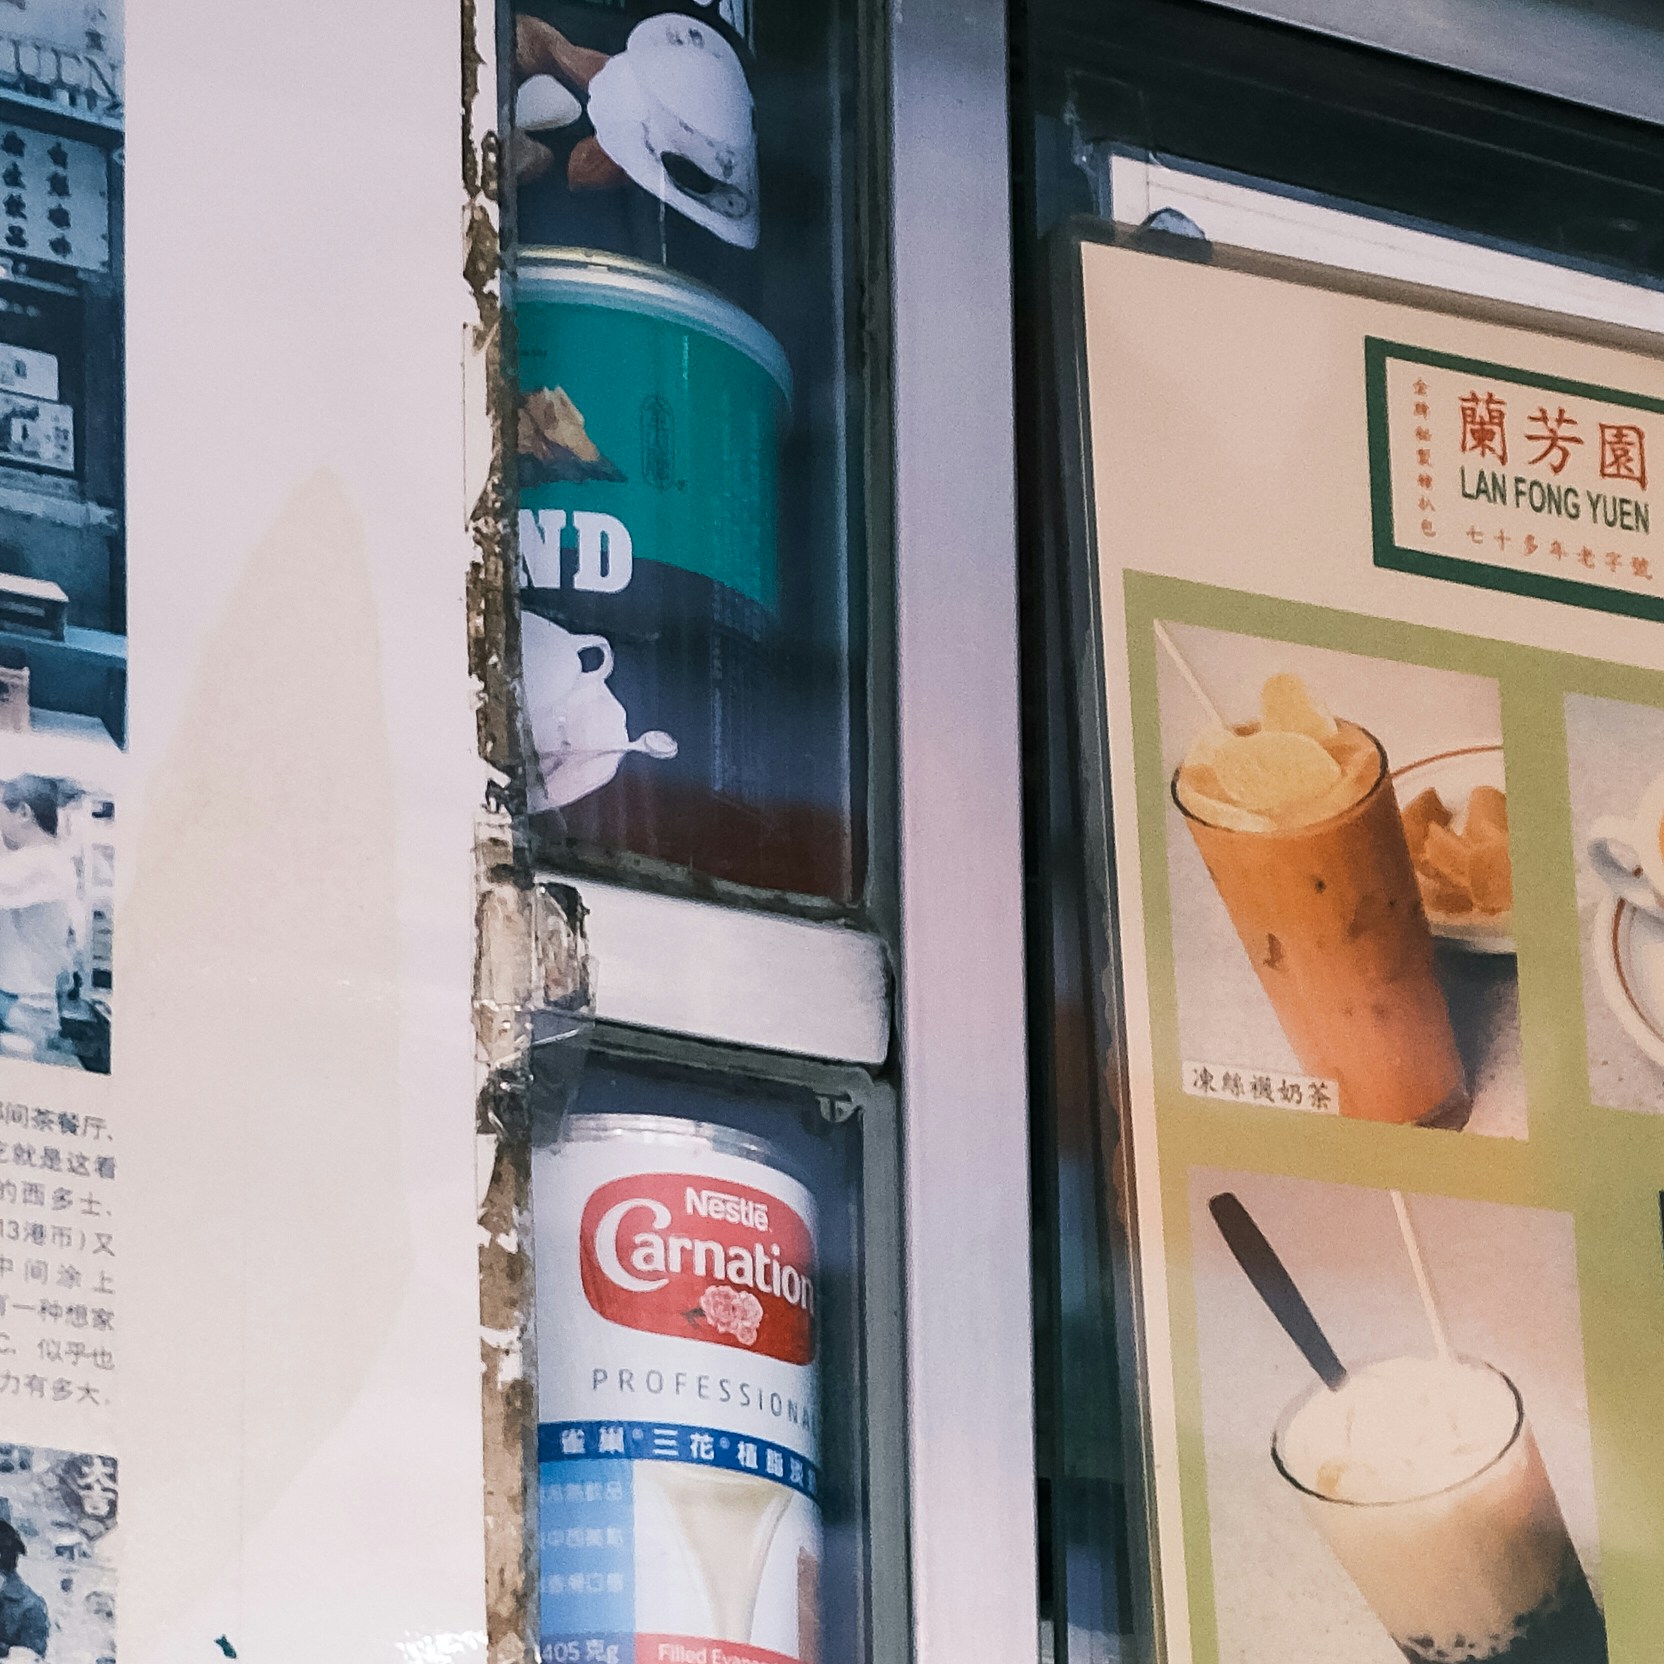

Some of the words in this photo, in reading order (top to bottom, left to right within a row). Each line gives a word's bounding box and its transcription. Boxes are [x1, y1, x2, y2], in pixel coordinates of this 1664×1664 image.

[1459, 391, 1648, 492] 蘭芳園
[1461, 465, 1507, 506] LAN
[1513, 476, 1581, 521] FONG
[1587, 489, 1650, 535] YUEN
[1466, 525, 1653, 581] 七十多年老字號
[0, 1102, 113, 1141] 间茶餐厅、
[685, 1187, 770, 1232] Nestlé
[595, 1198, 815, 1312] Carnation
